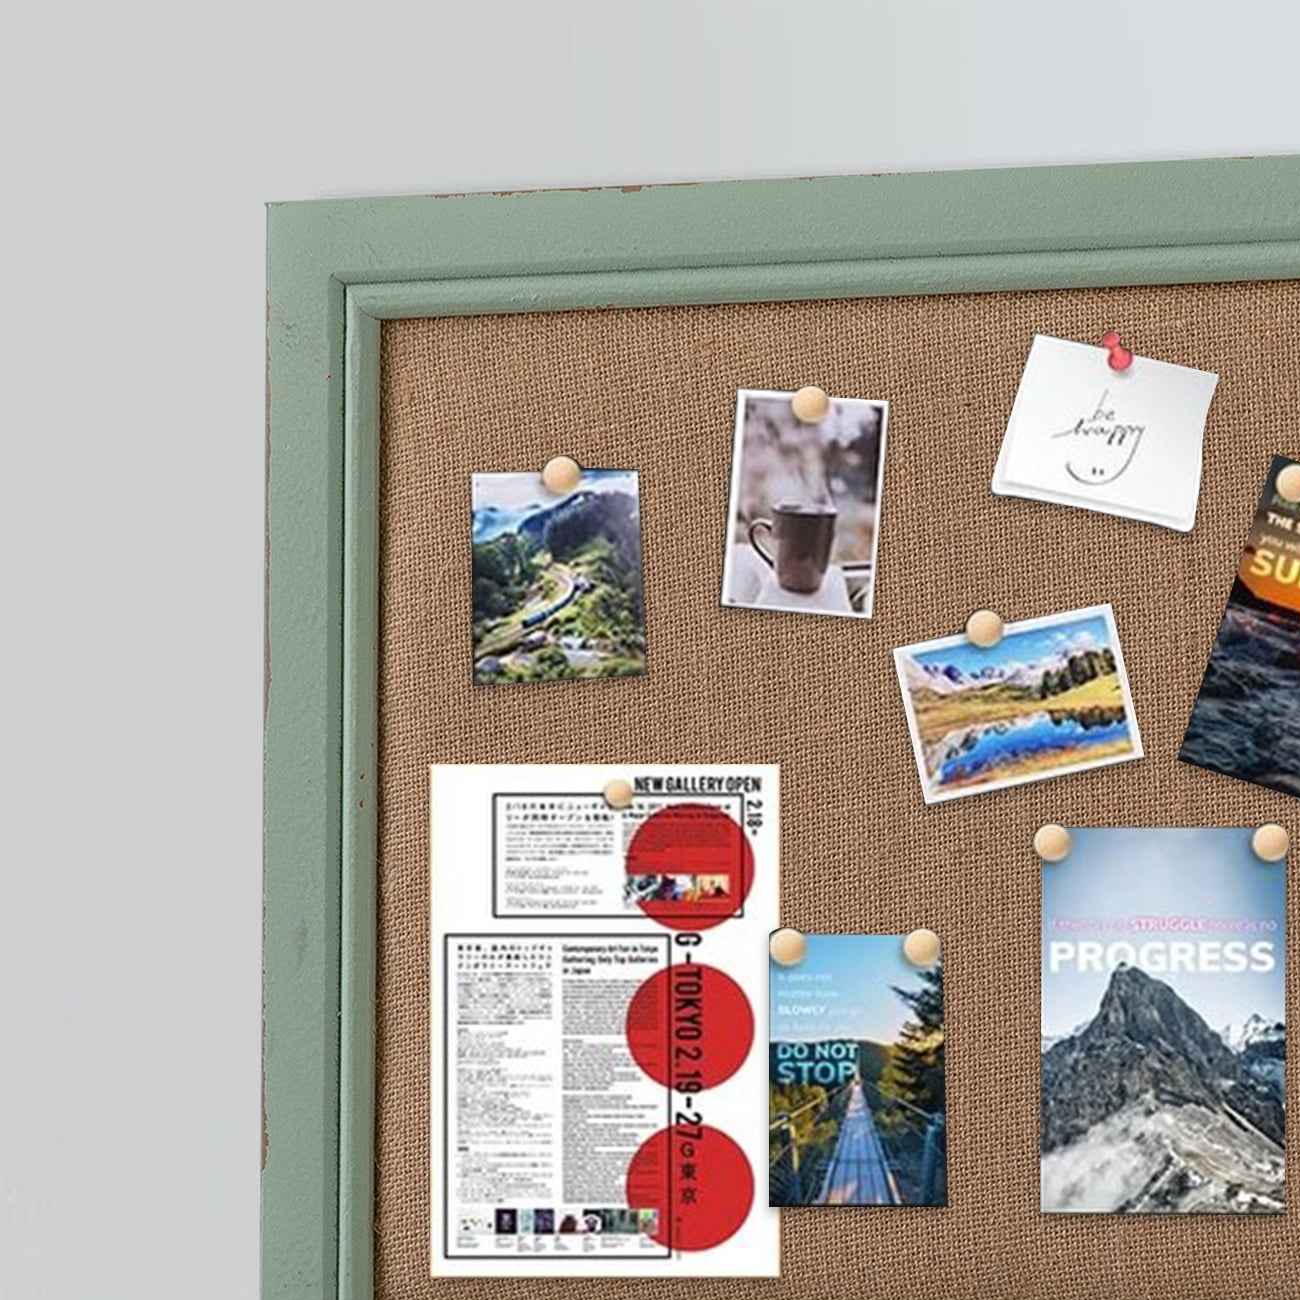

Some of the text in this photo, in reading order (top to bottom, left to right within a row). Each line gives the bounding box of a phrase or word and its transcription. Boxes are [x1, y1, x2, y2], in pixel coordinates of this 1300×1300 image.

[1087, 388, 1115, 422] be
[1266, 511, 1292, 531] THE
[1259, 534, 1284, 550] you
[634, 776, 762, 793] NEW GALLERY OPEN
[1130, 919, 1203, 932] STRUGGLE
[1049, 941, 1276, 973] PROGRESS
[777, 1004, 827, 1016] SLOWLY
[777, 1043, 859, 1059] DO NOT
[777, 1061, 857, 1085] STOP
